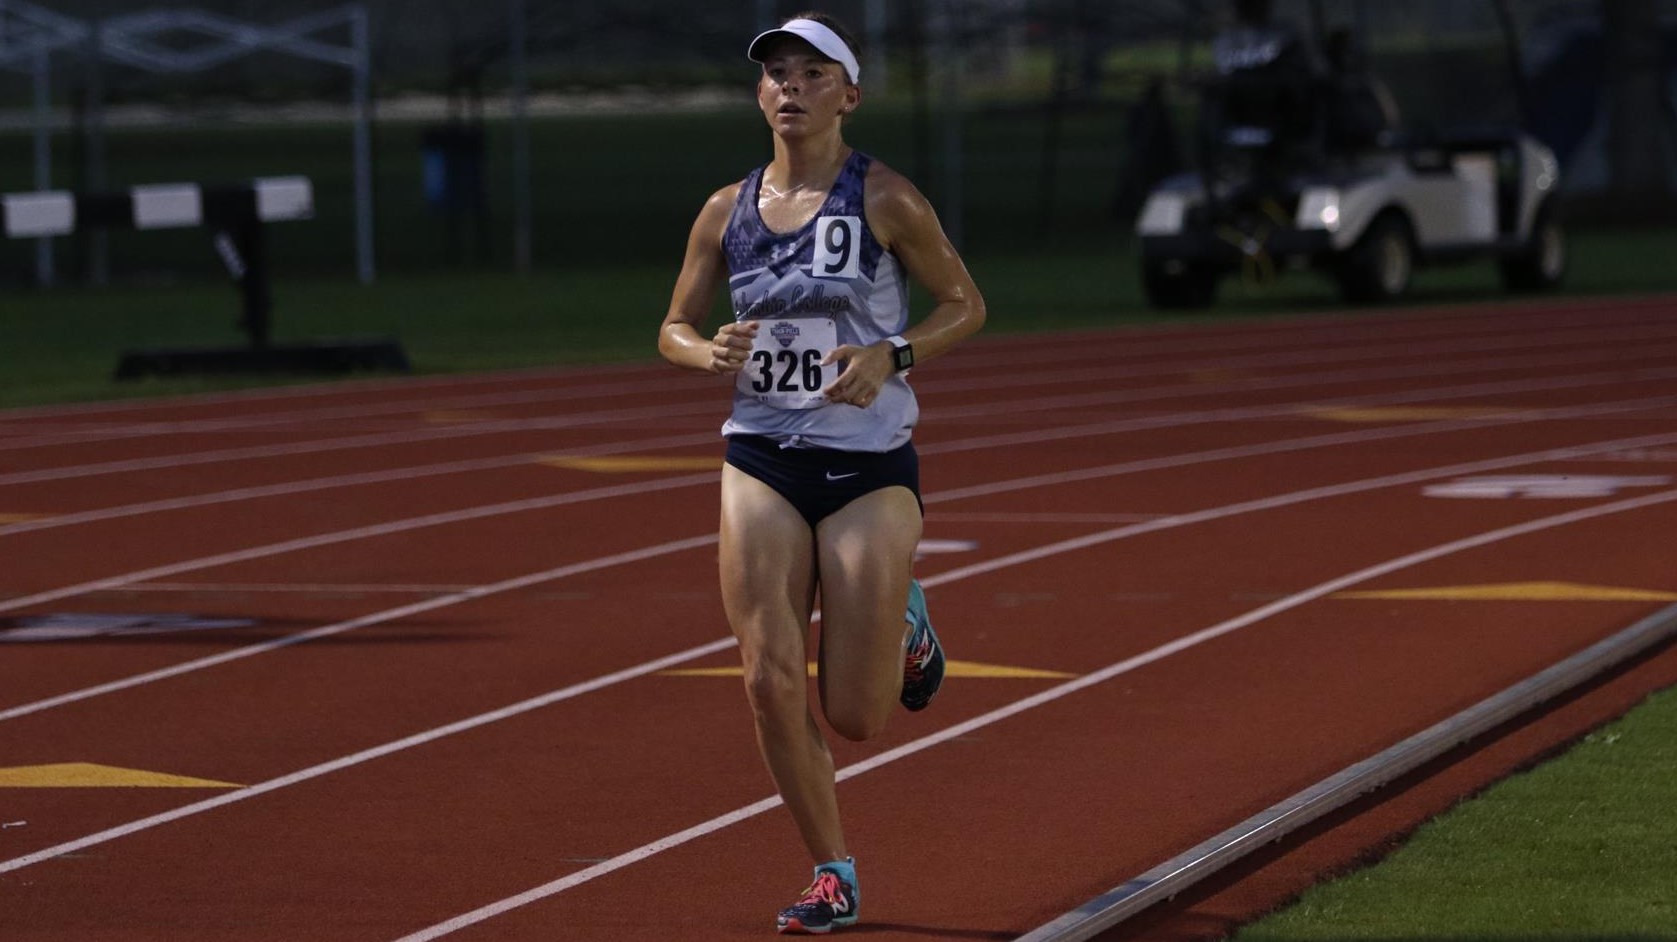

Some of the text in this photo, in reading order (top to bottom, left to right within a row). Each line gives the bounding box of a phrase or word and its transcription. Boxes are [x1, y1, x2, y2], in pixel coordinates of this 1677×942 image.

[824, 219, 851, 274] 9
[791, 284, 850, 321] College
[752, 349, 822, 393] 326
